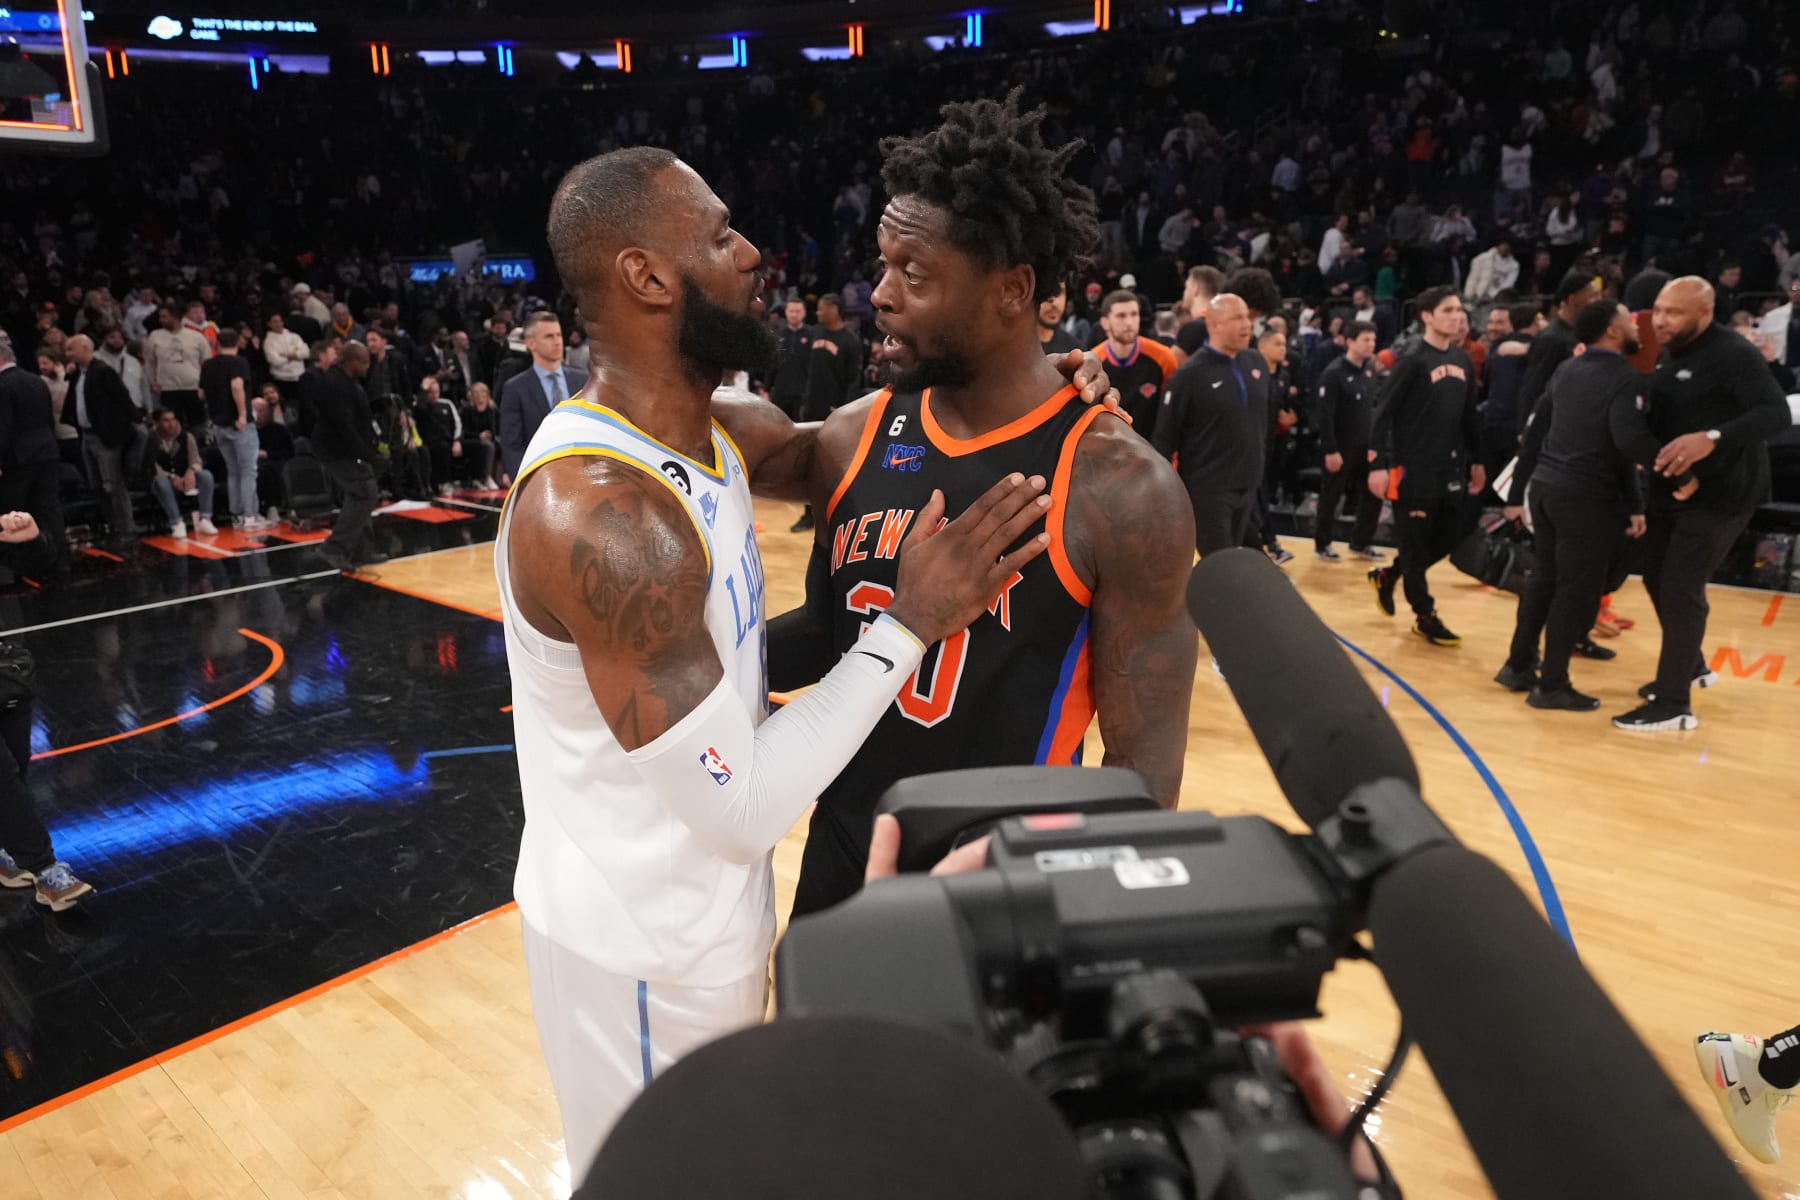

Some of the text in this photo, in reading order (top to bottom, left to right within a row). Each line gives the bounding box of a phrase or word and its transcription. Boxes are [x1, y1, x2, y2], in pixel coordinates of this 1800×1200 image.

[224, 19, 242, 31] THE
[276, 21, 294, 32] THE
[888, 414, 907, 437] 6
[881, 443, 926, 472] NYC
[831, 508, 915, 576] NEW
